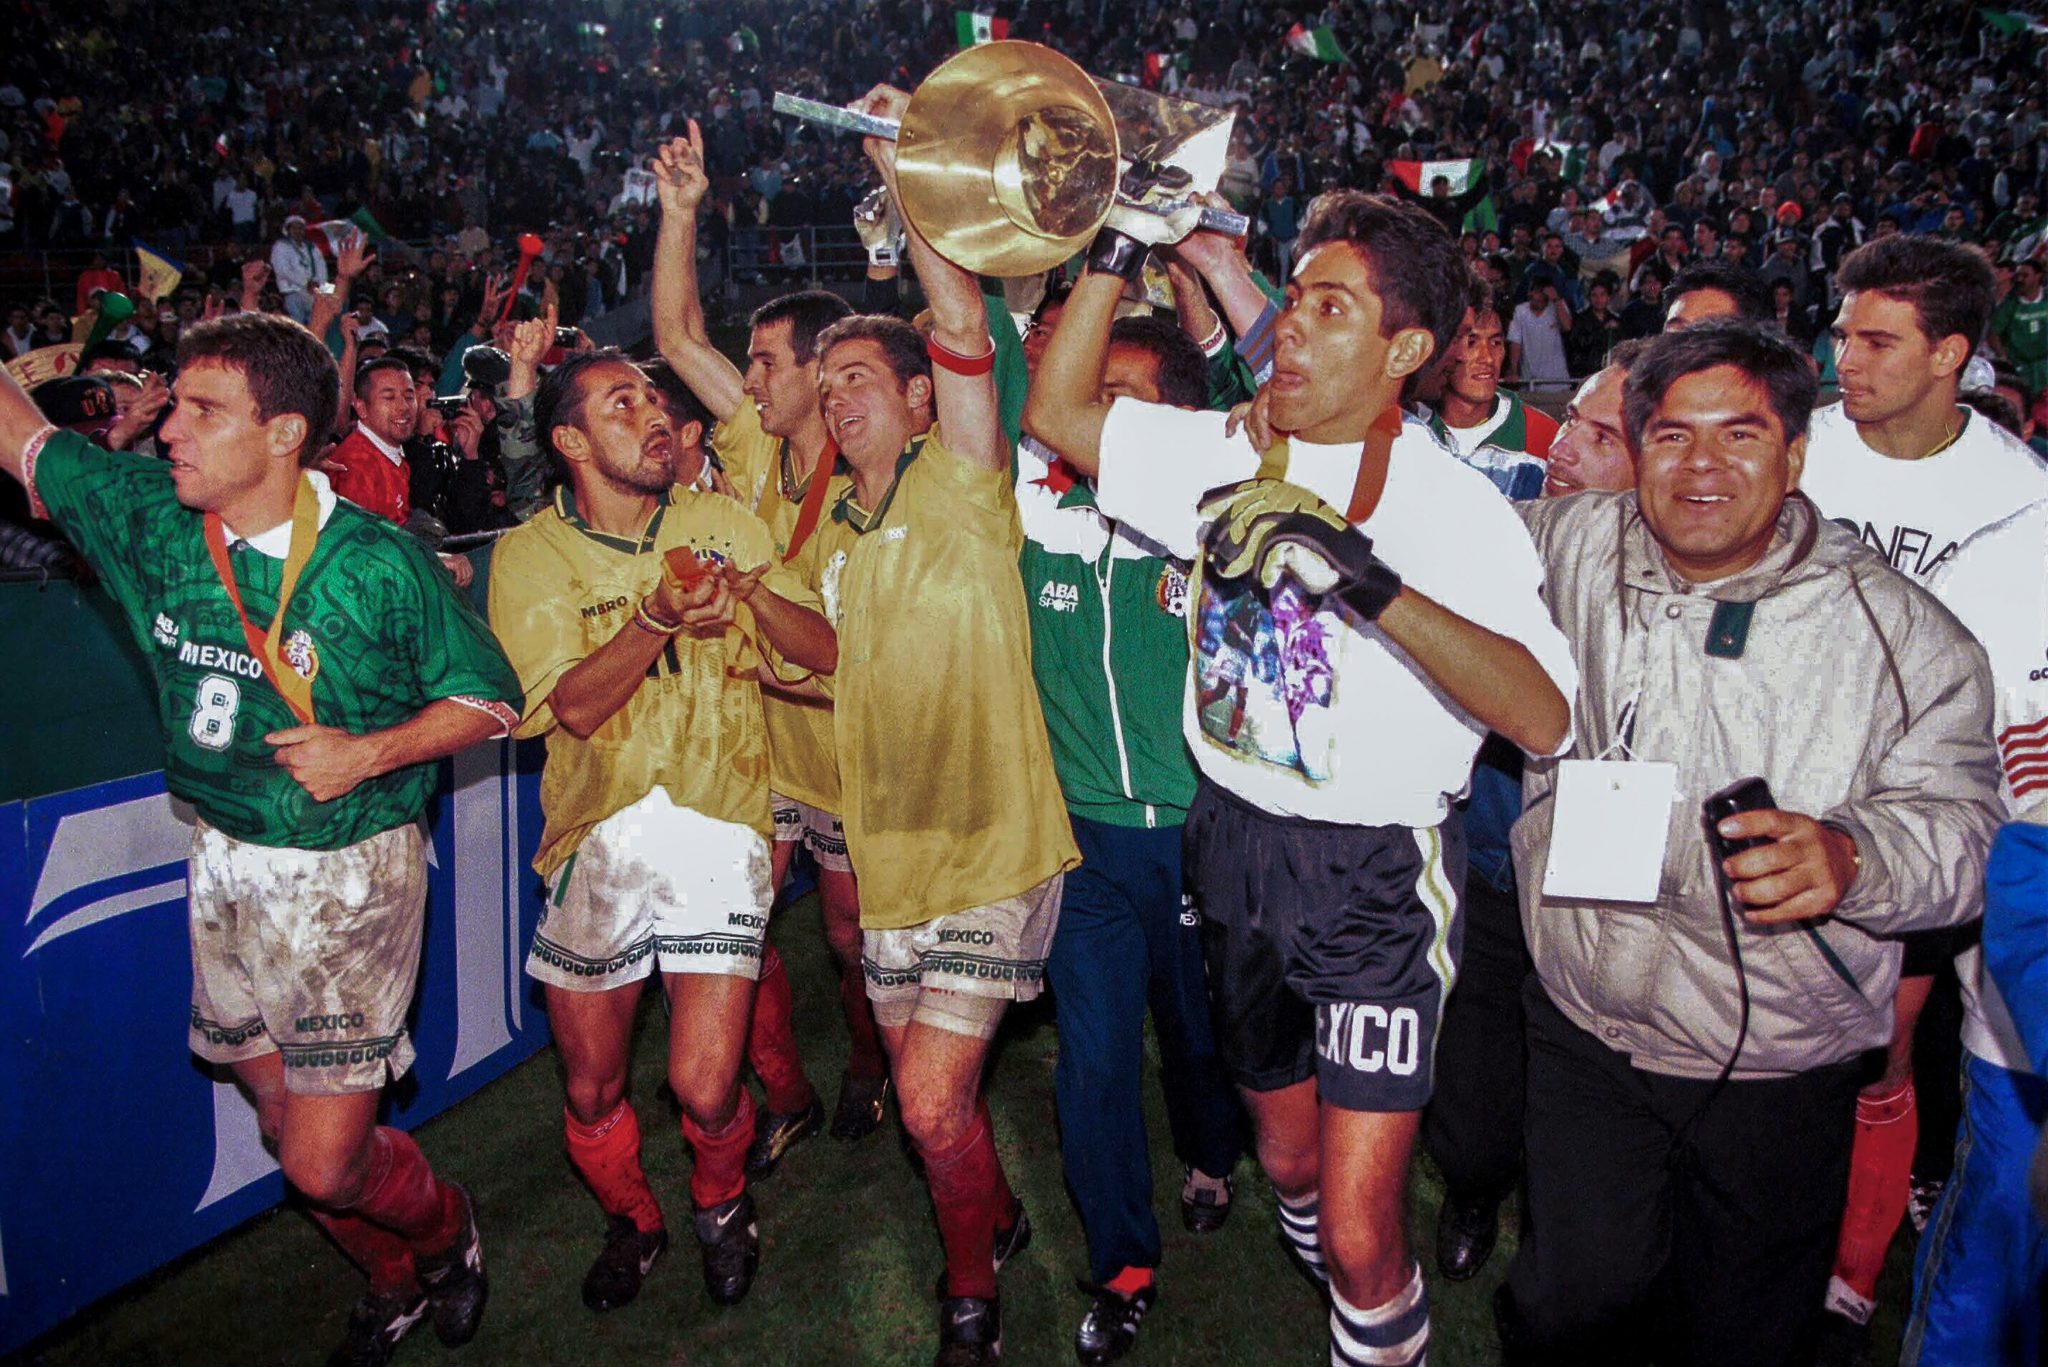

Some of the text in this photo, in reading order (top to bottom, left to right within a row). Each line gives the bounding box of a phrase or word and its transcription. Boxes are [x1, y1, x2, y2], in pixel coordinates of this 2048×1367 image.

[1041, 580, 1078, 602] ABA
[1039, 595, 1078, 613] SPORT
[179, 641, 263, 679] MEXICO
[188, 673, 241, 752] 8
[936, 929, 994, 946] MEXICO
[296, 1012, 364, 1033] MEXICO
